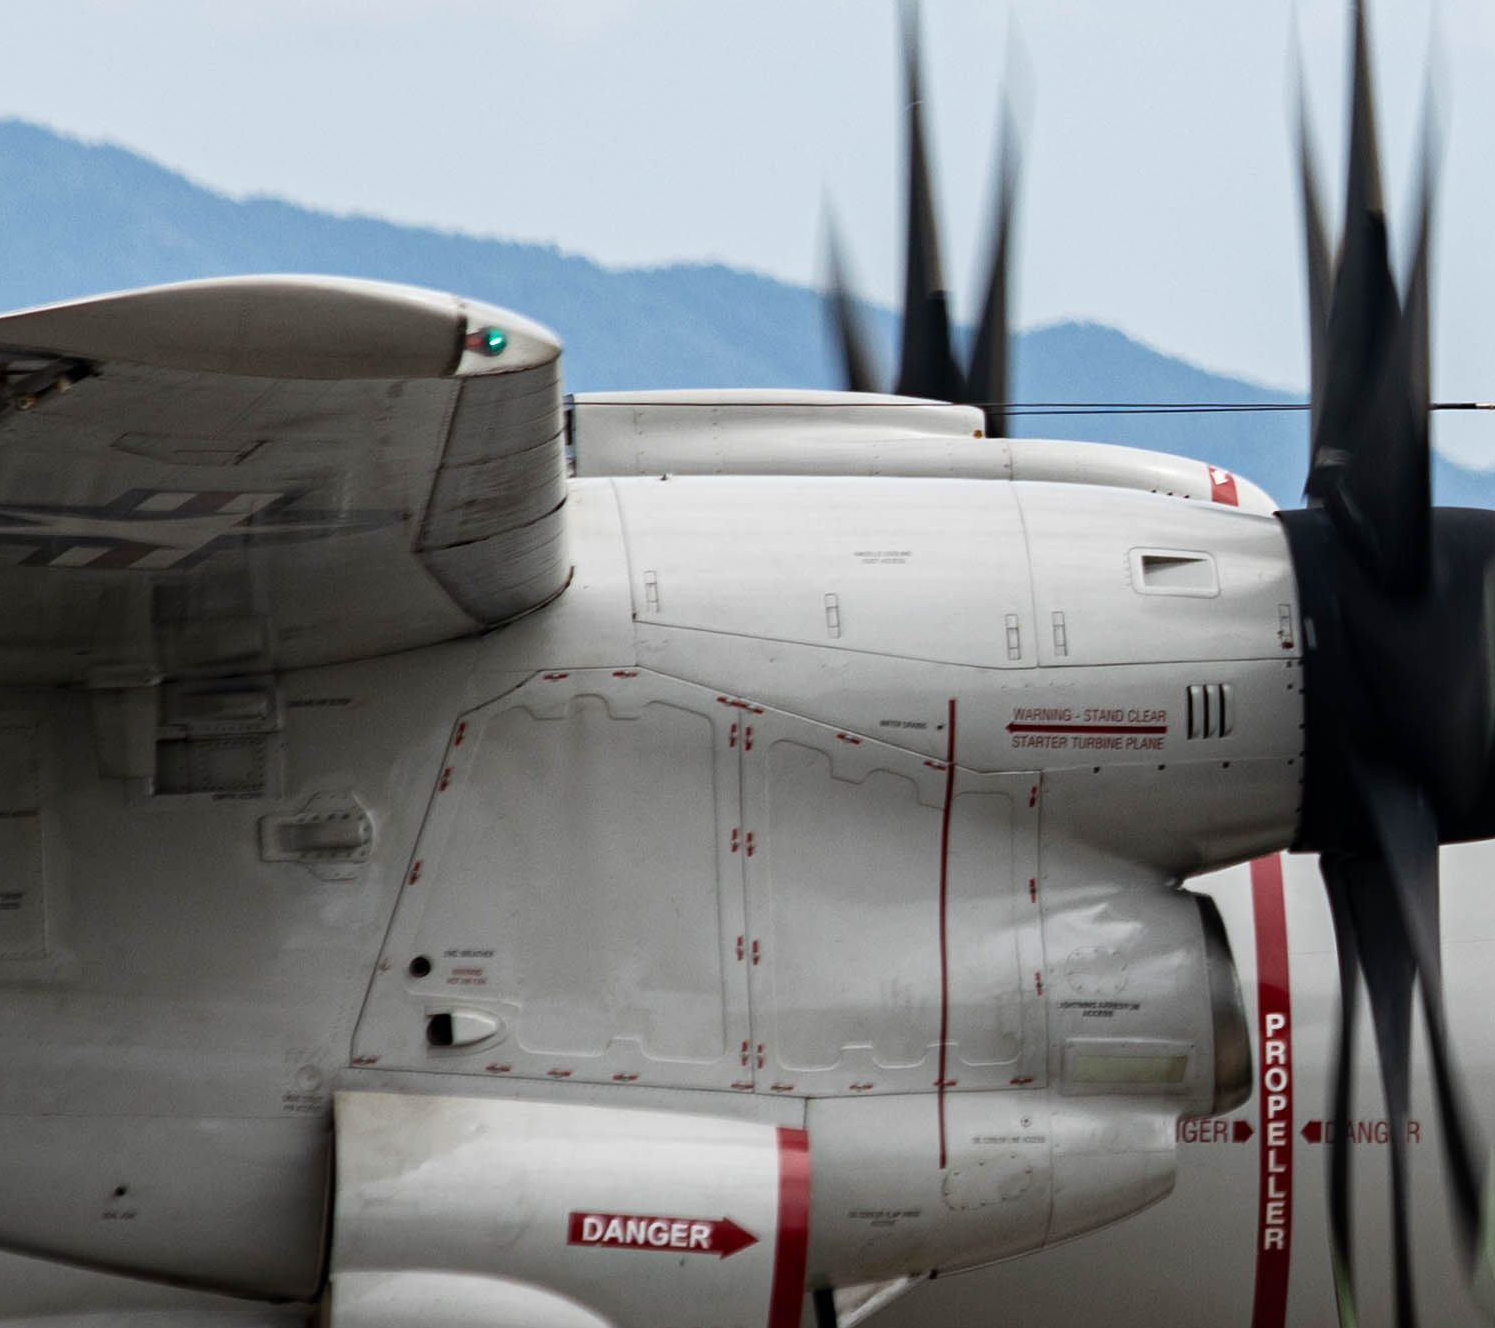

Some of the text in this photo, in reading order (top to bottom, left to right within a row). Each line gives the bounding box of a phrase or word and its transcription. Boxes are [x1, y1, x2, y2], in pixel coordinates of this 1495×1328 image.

[1013, 708, 1072, 722] WARNING
[1083, 709, 1124, 722] STAND
[1127, 709, 1167, 723] CLEAR
[1011, 735, 1166, 751] STARTER TURBINE PLANE
[1263, 1012, 1289, 1251] PROPELLER
[582, 1217, 711, 1249] DANGER
